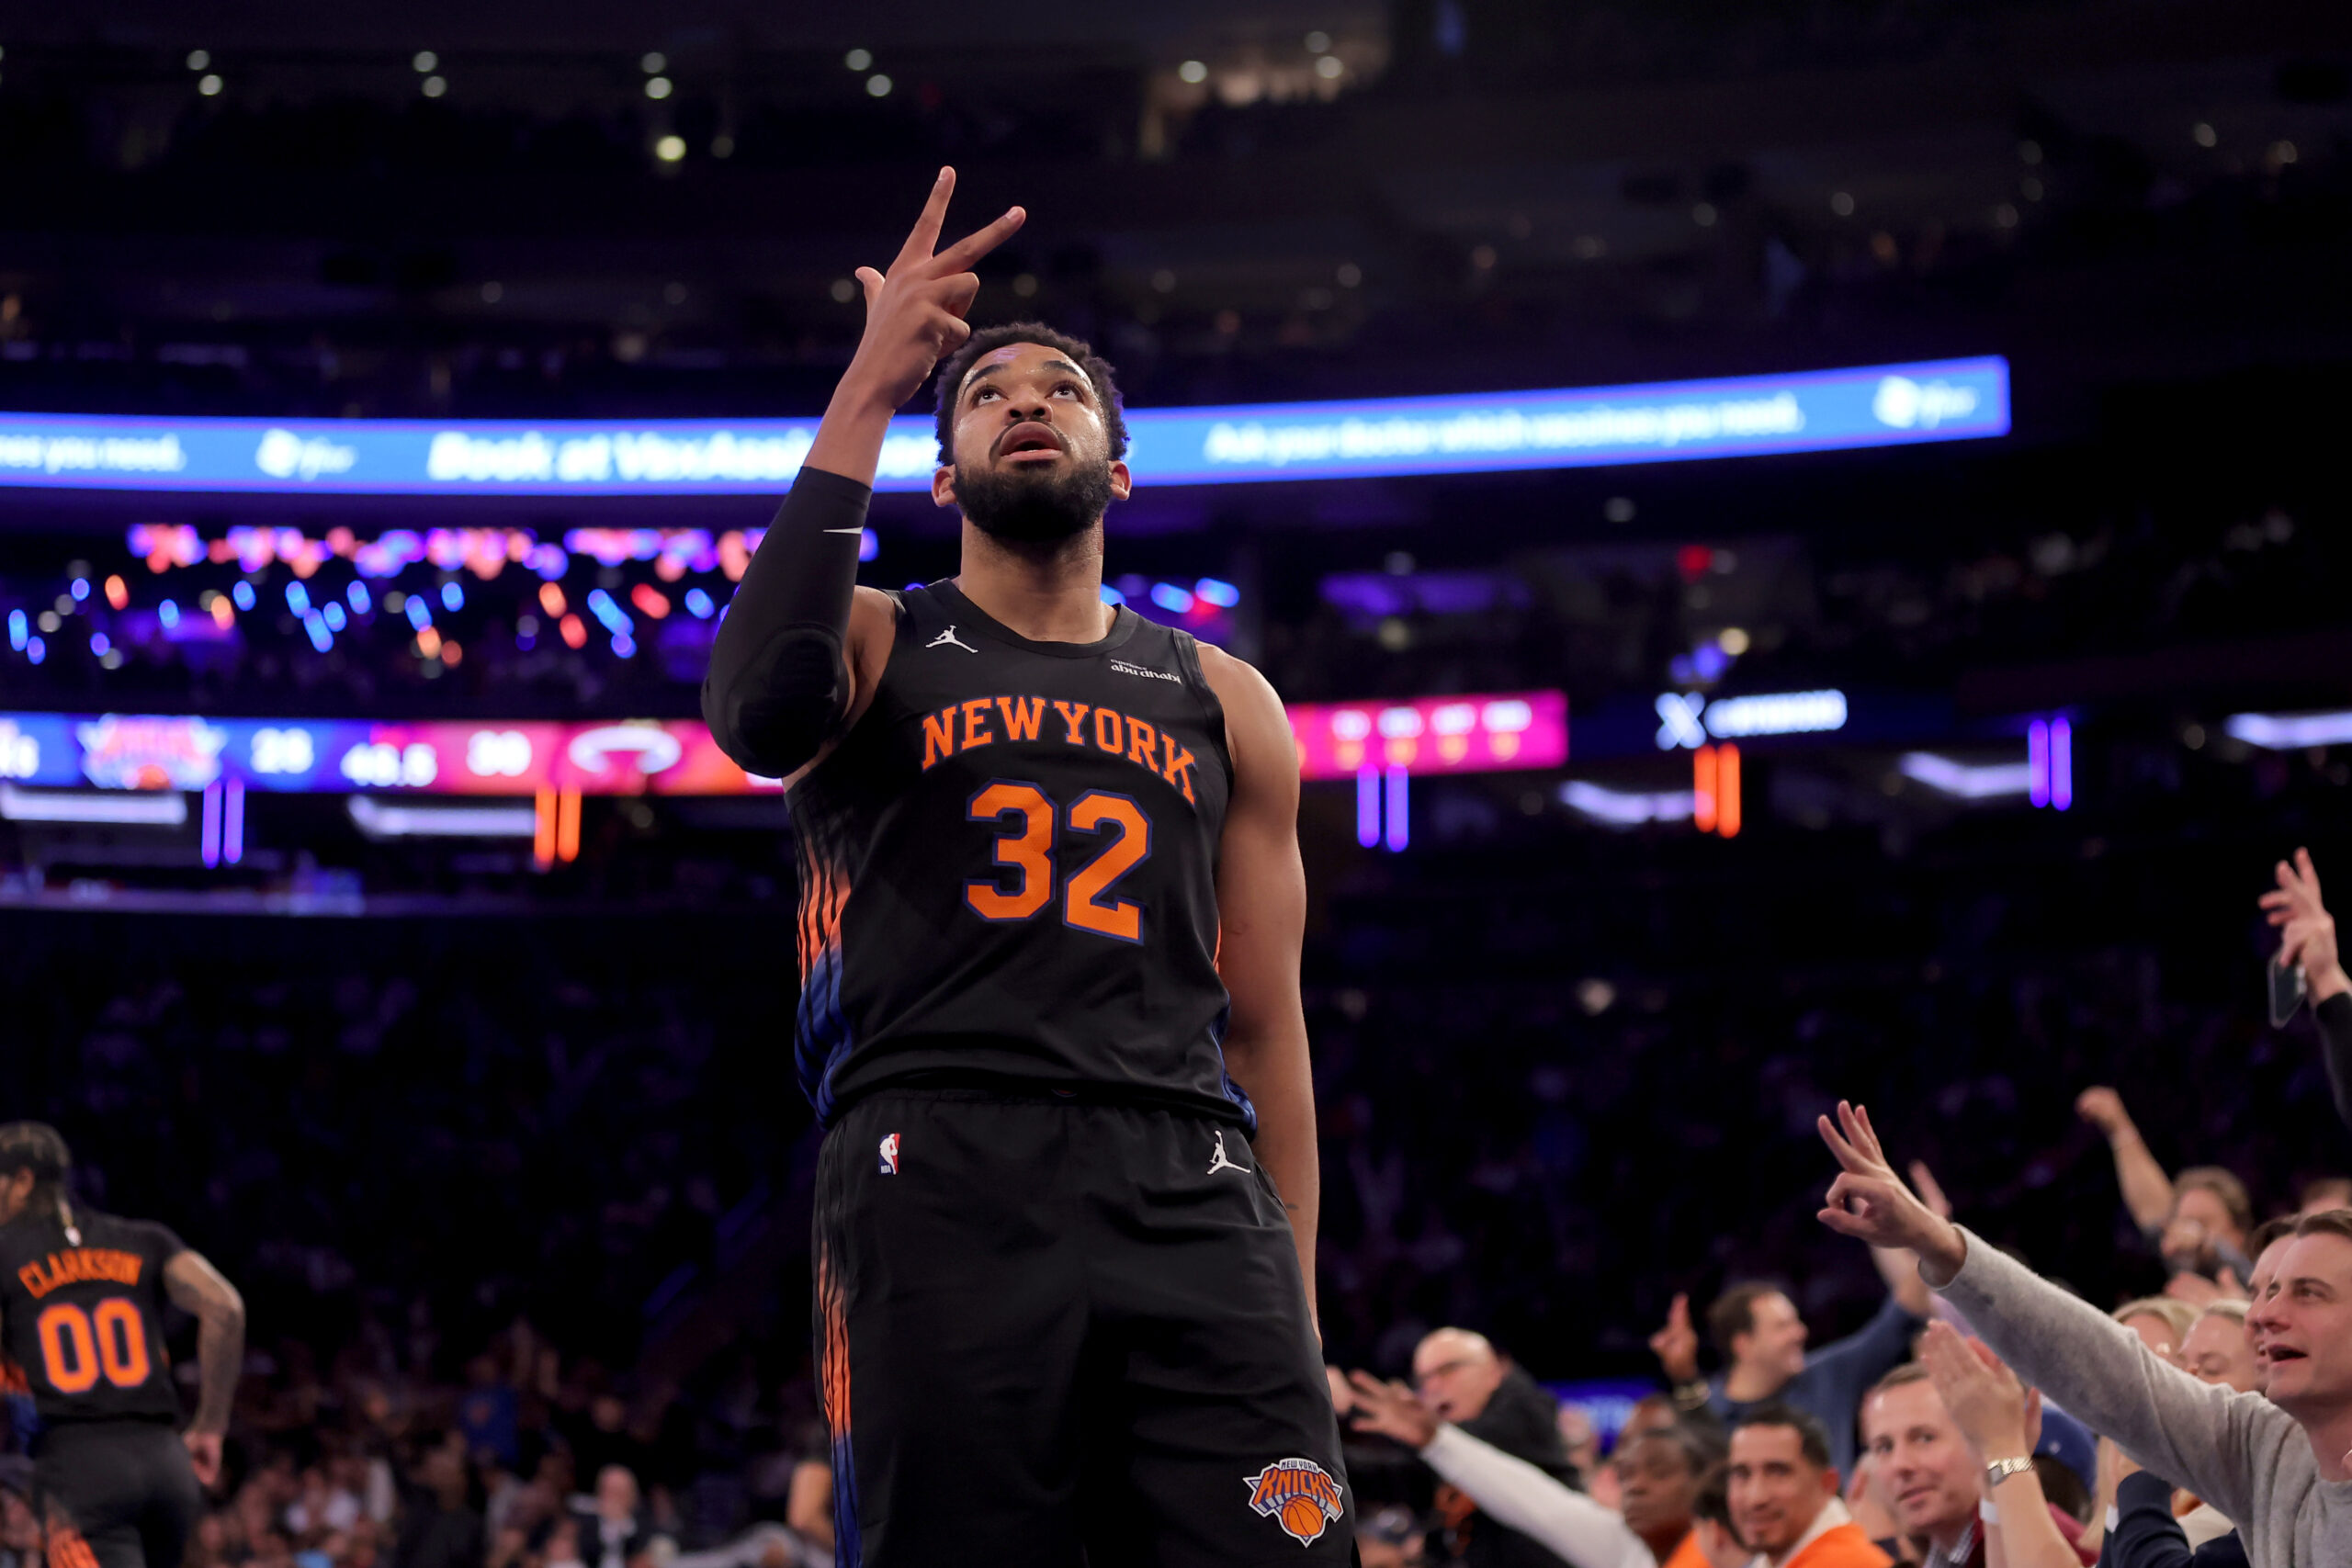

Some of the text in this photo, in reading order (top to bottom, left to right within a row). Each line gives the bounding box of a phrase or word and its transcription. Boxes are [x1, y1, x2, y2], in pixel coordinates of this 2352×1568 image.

[1111, 664, 1182, 685] abu dhabi
[922, 695, 1196, 807] NEW YORK
[963, 777, 1153, 946] 32
[17, 1247, 143, 1300] CLARKSON
[37, 1296, 151, 1394] 00
[1252, 1467, 1342, 1513] KNICKS
[1281, 1461, 1318, 1472] NEW YORK
